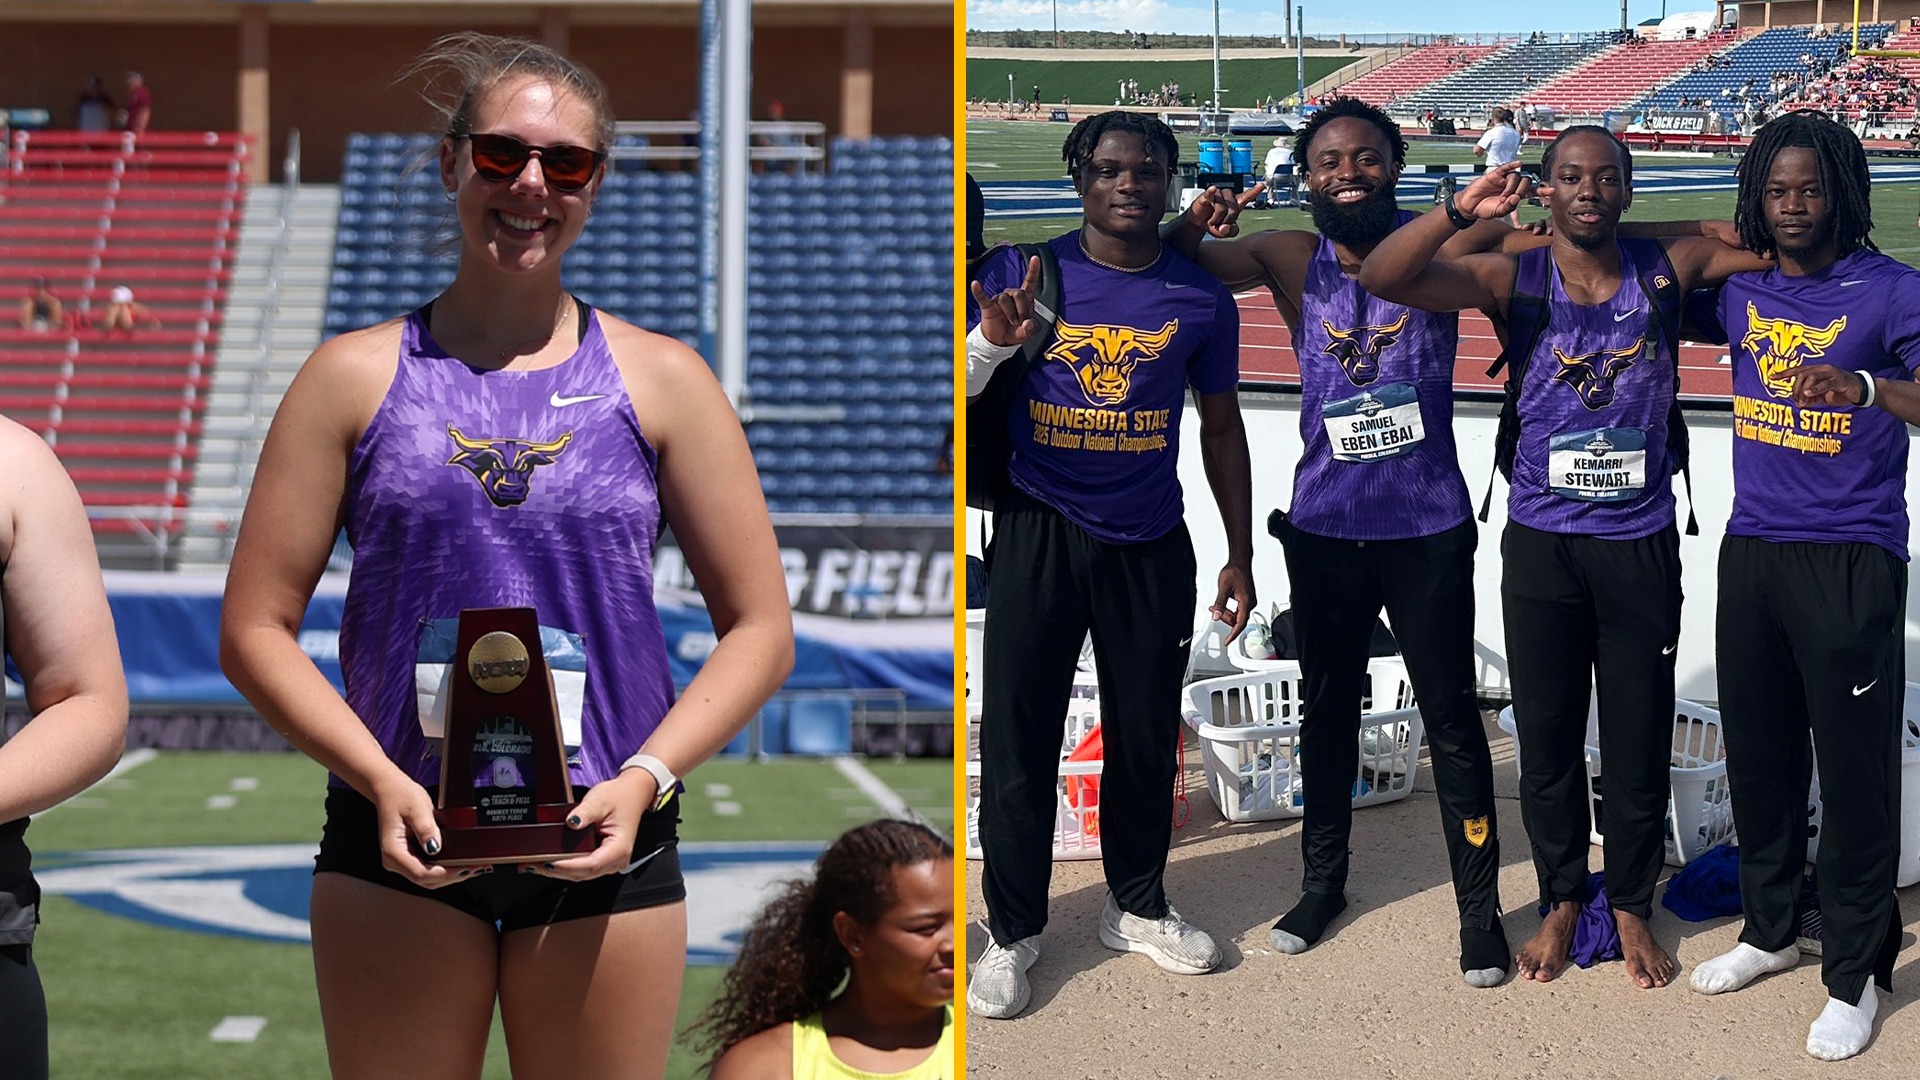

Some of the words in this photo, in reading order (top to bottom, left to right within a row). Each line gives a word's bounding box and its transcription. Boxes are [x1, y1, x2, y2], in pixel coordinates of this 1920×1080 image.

[1652, 116, 1674, 129] RACK
[1680, 117, 1704, 130] FIELD
[1029, 399, 1128, 432] MINNESOTA
[1133, 408, 1170, 432] STATE
[1351, 415, 1397, 434] SAMUEL
[1800, 409, 1853, 435] STATE
[1033, 423, 1050, 445] 2025
[1050, 427, 1083, 449] Outdoor
[1083, 431, 1118, 452] National
[1118, 430, 1168, 456] Championships
[1340, 432, 1378, 452] EBEN
[1380, 425, 1414, 447] EBAI
[1758, 422, 1785, 446] National
[1782, 428, 1842, 457] Championships
[1573, 458, 1623, 471] KEMARRI
[1565, 471, 1631, 488] STEWART
[811, 548, 954, 615] FIELD
[474, 657, 527, 680] NCAA
[1471, 827, 1483, 836] 30
